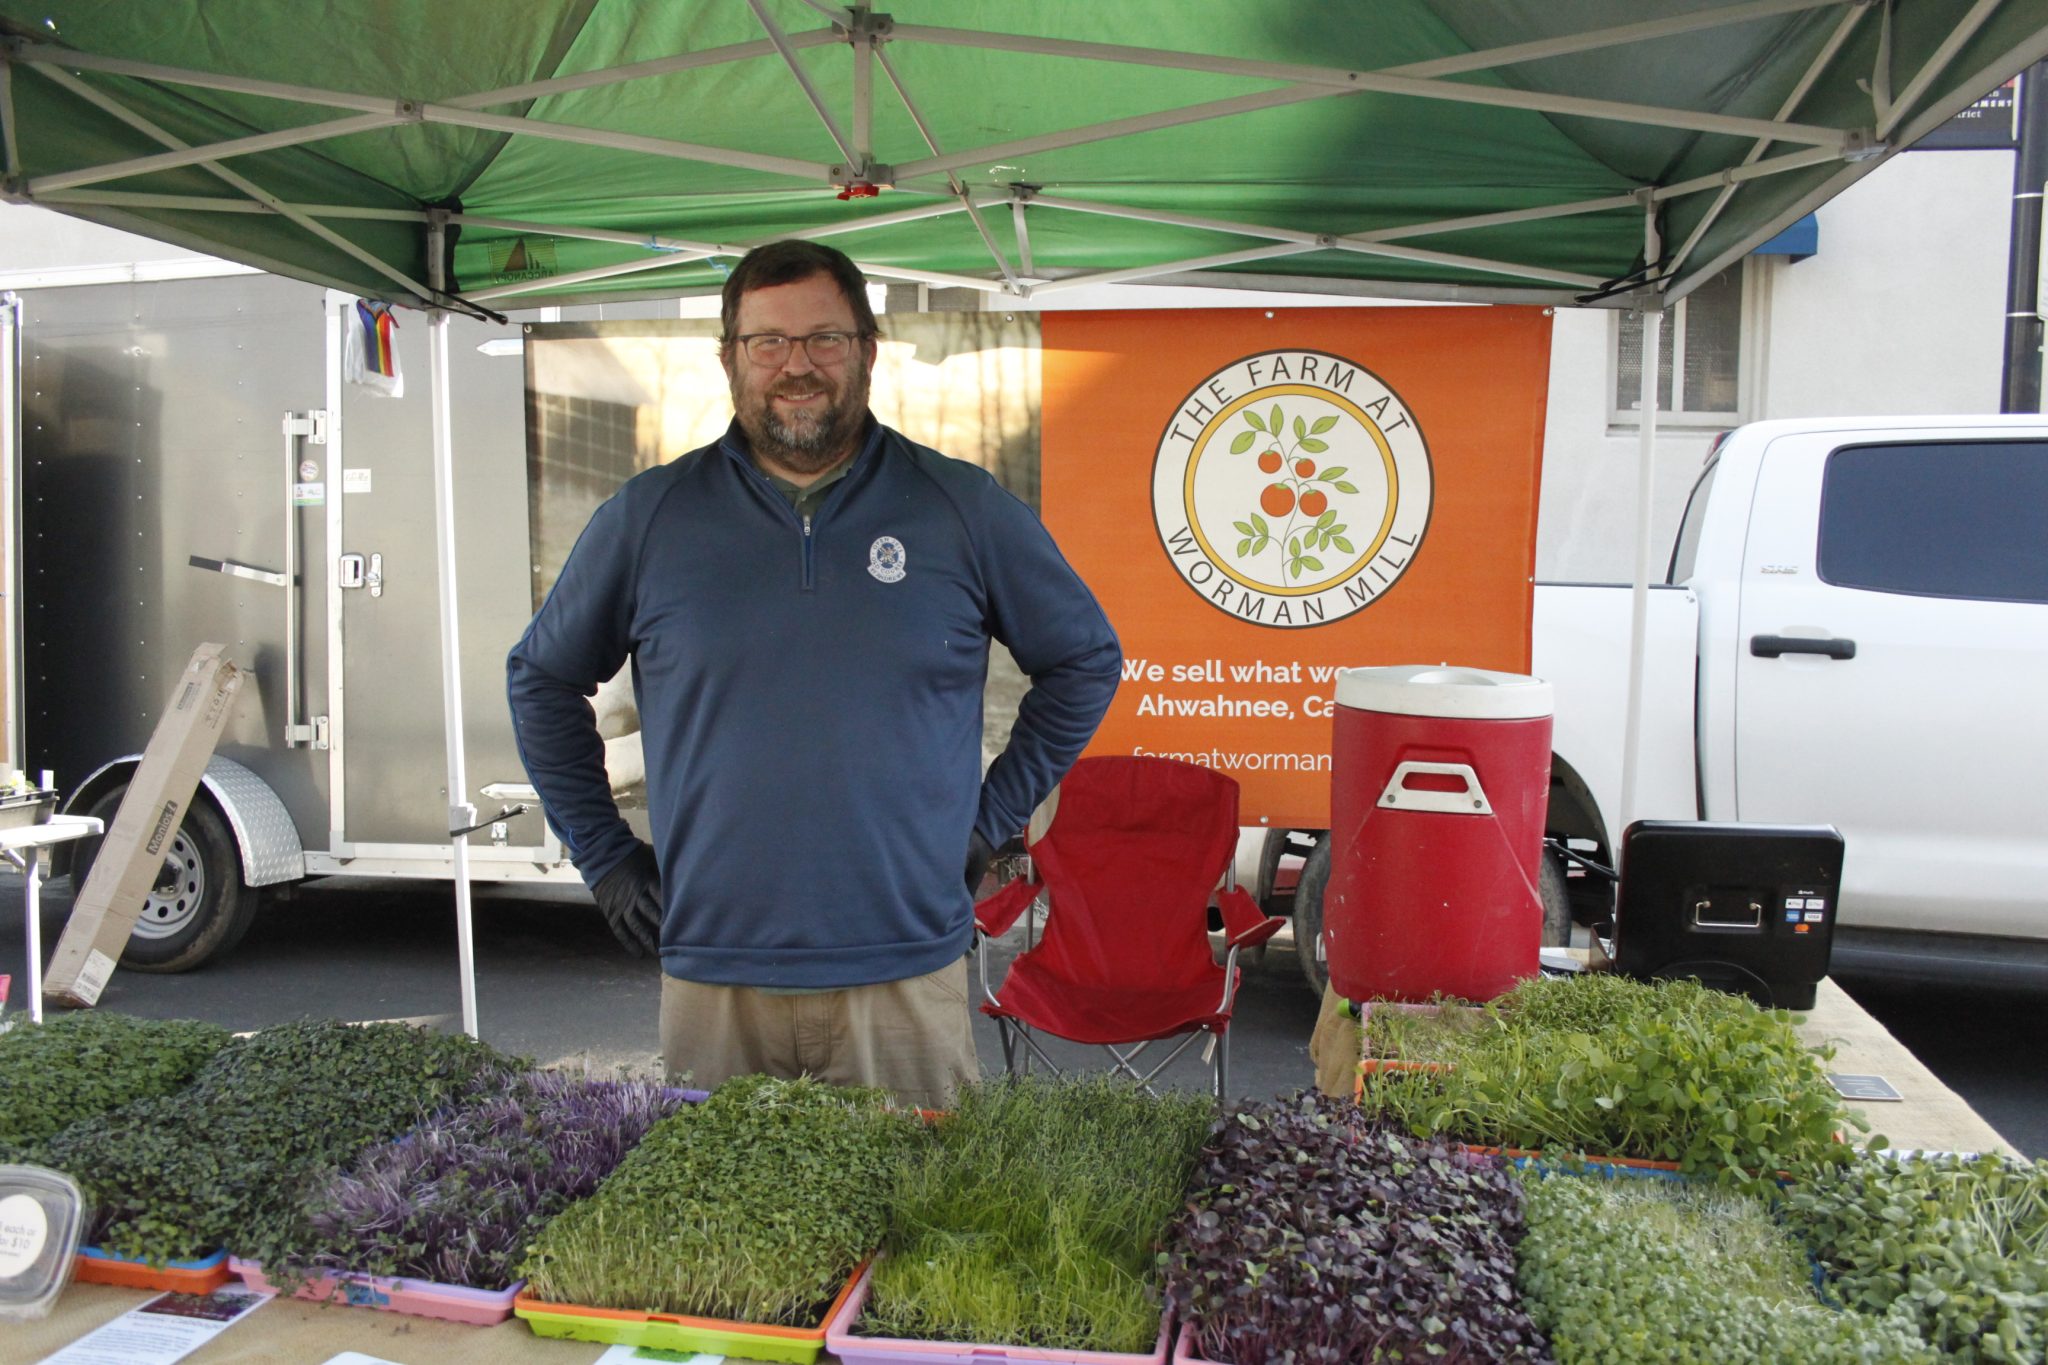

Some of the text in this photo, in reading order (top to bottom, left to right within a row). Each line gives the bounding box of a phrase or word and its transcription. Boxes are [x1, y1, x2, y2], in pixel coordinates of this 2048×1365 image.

[1954, 110, 1981, 119] trict
[1169, 355, 1411, 443] THE FARM AT
[1167, 526, 1418, 625] WORMAN MILL
[1121, 659, 1165, 682] We
[1172, 659, 1225, 683] sell
[1229, 660, 1302, 684] what
[1136, 694, 1295, 721] Ahwahnee,
[1133, 746, 1333, 772] matworman
